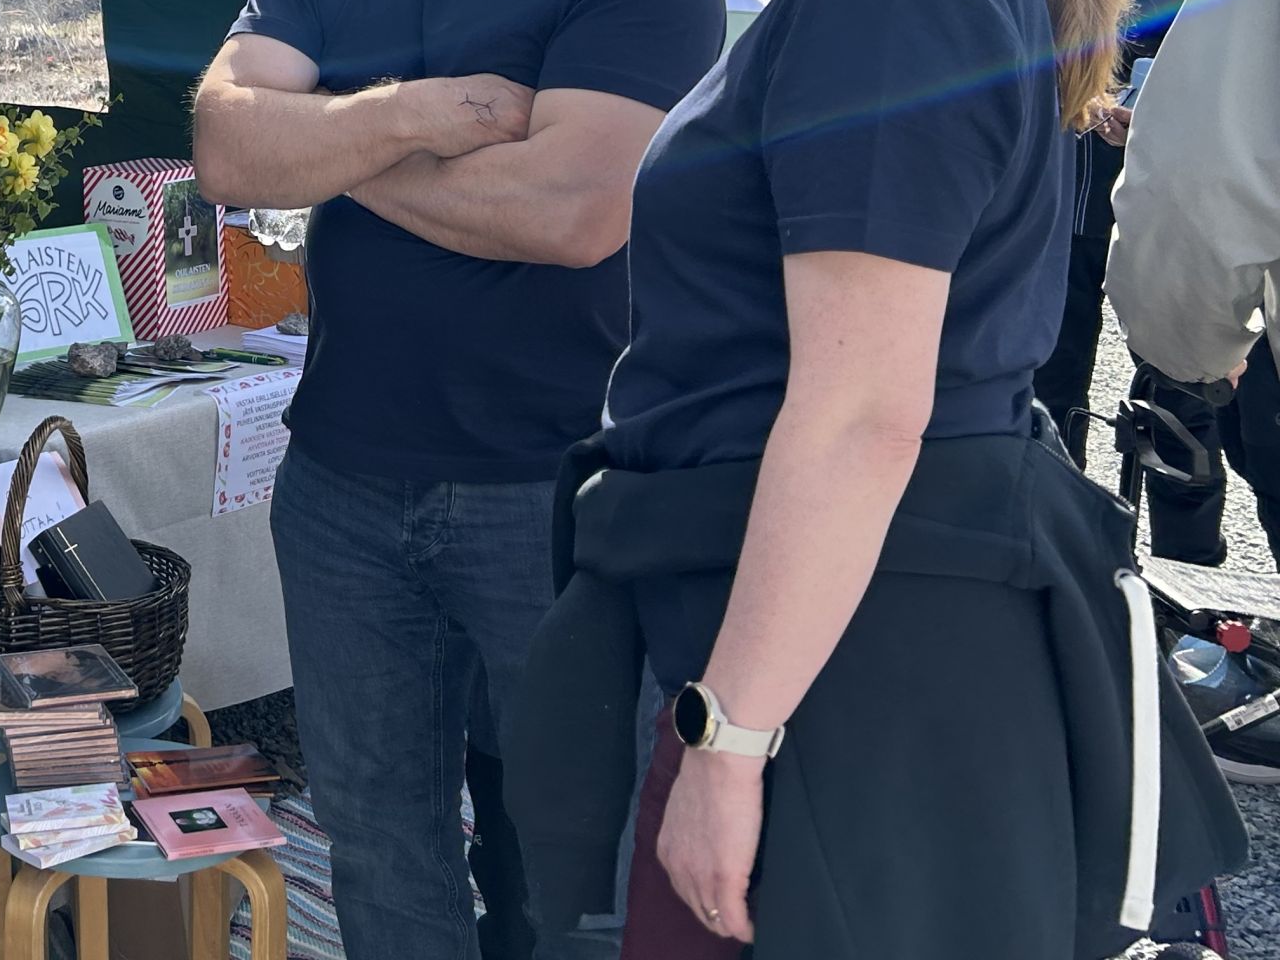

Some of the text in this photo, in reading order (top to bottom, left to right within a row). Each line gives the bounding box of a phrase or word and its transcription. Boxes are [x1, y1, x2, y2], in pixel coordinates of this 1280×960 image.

[93, 200, 147, 219] Marianne
[4, 246, 91, 286] ULAISTEN
[14, 268, 109, 337] SRK
